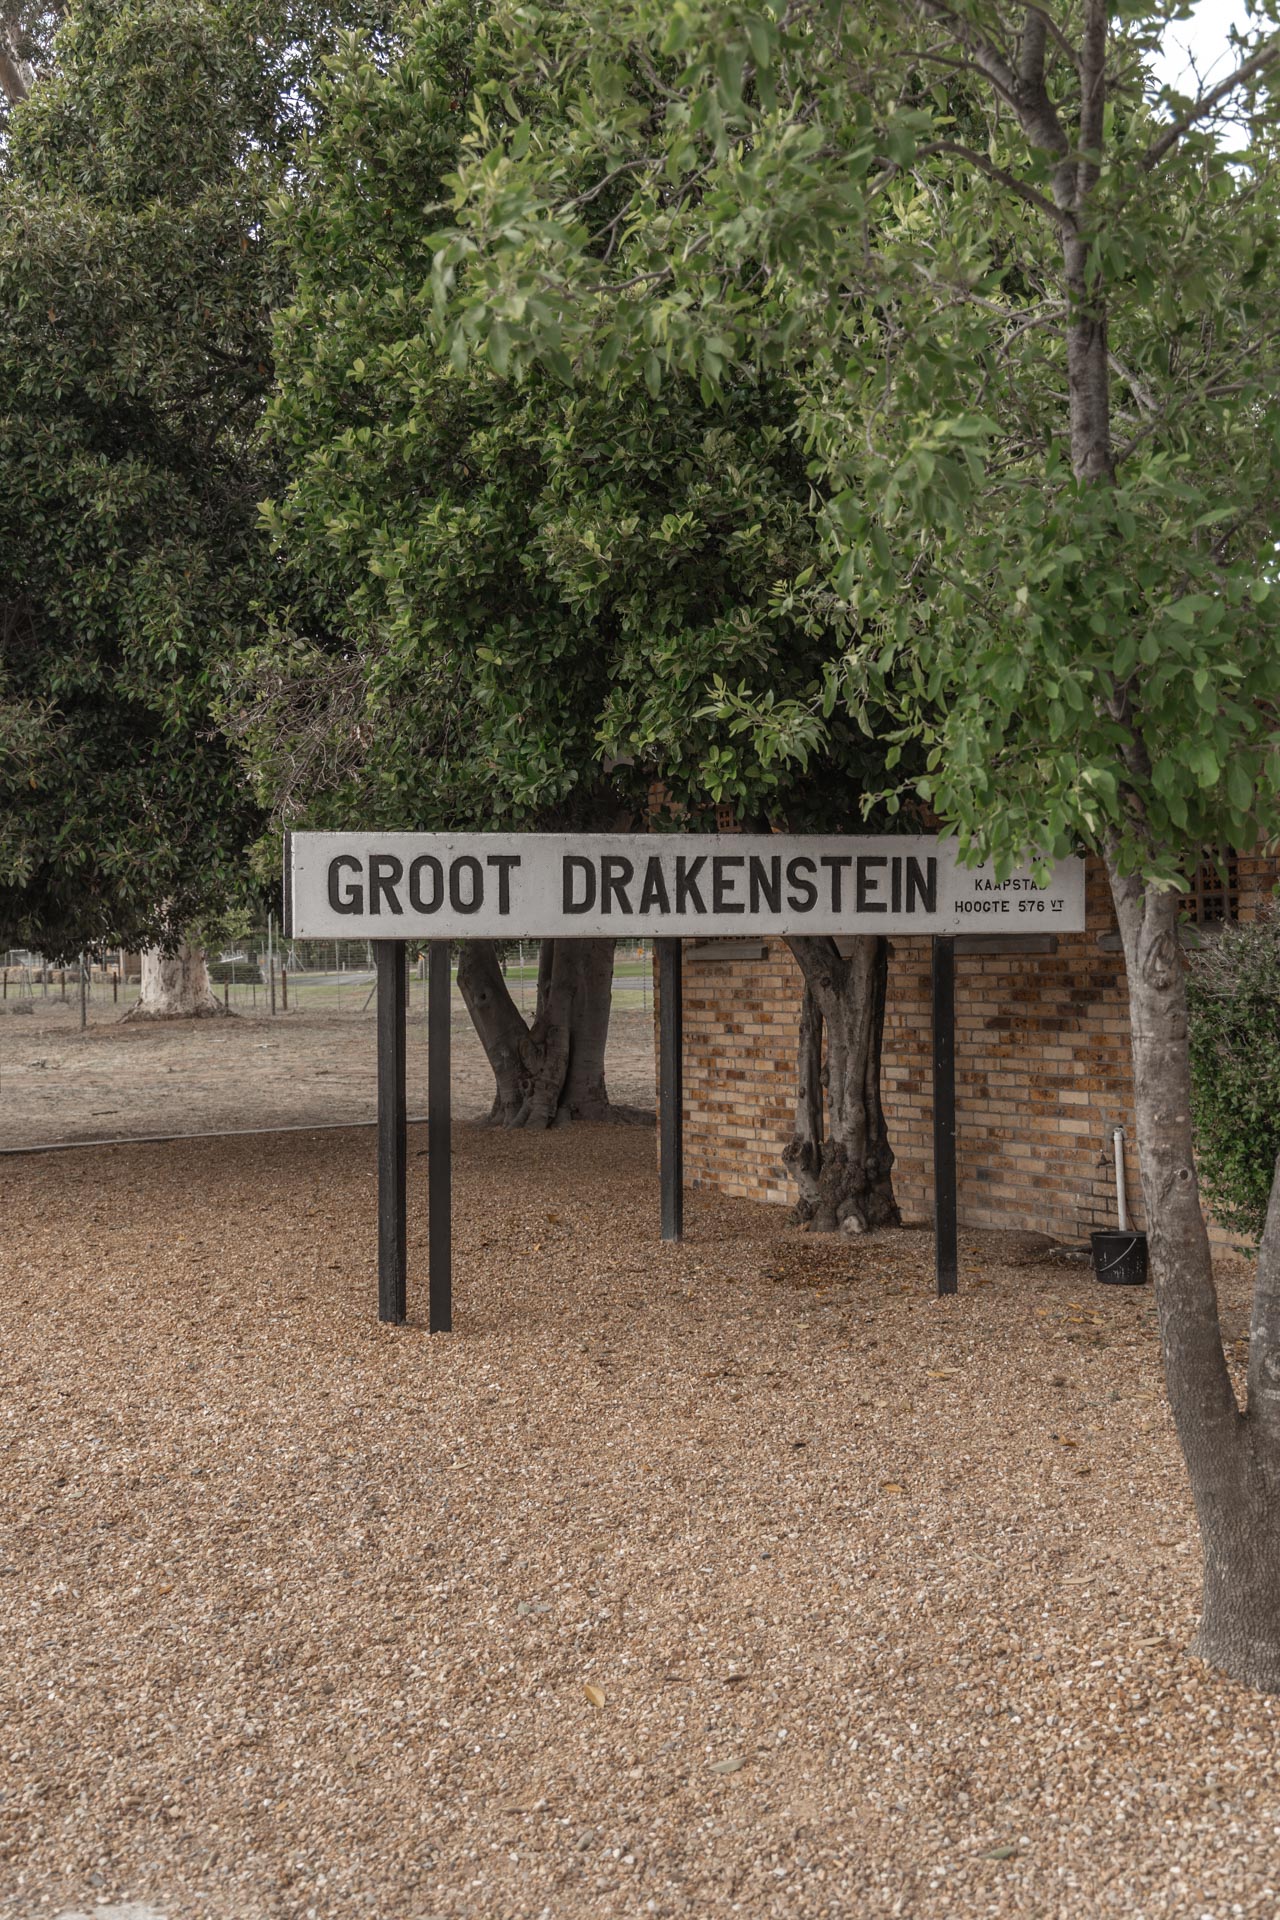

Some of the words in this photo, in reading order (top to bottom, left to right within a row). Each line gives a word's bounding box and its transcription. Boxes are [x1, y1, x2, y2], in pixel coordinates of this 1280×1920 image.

[328, 855, 522, 915] GROOT
[562, 855, 938, 914] DRAKENSTEIN
[975, 879, 1048, 891] KAAPSTA
[1018, 901, 1045, 913] 576
[1050, 900, 1064, 912] VT
